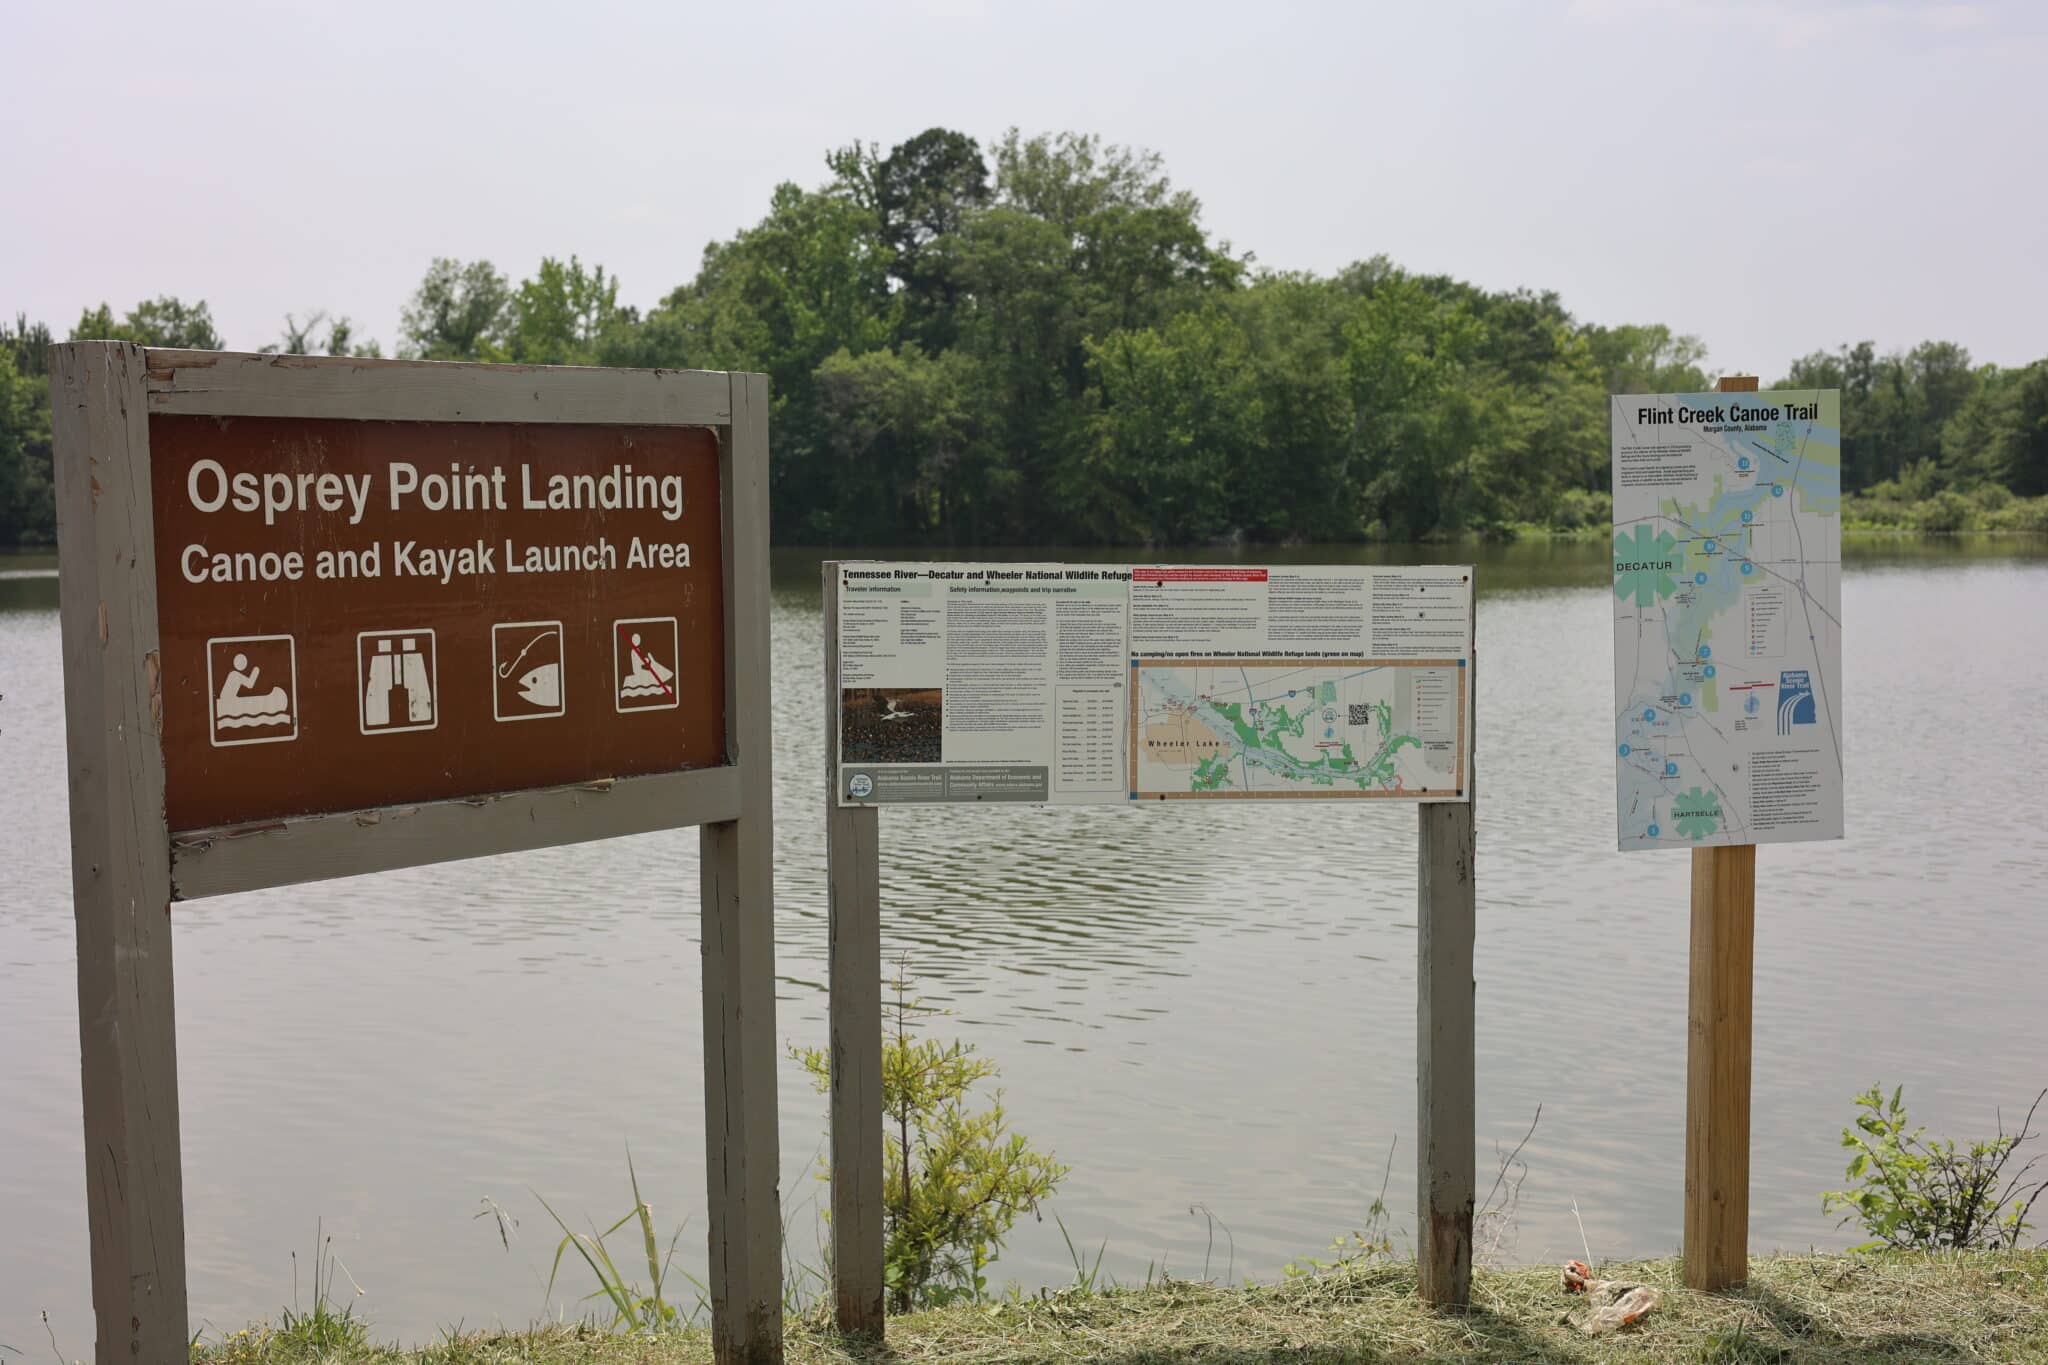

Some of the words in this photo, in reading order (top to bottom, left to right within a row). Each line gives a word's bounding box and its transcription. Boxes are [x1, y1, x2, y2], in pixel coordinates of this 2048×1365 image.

[1638, 408, 1674, 425] Flint
[1678, 406, 1725, 424] Creek
[1729, 404, 1779, 422] Canoe
[1784, 403, 1818, 420] Trail
[1703, 425, 1723, 433] Morgan
[1724, 424, 1743, 432] County,
[1744, 424, 1767, 432] Alabama
[187, 458, 372, 525] Osprey
[388, 461, 507, 511] Point
[521, 463, 684, 521] Landing
[181, 543, 304, 583] Canoe
[315, 542, 381, 579] and
[394, 539, 495, 584] Kayak
[505, 537, 617, 573] Launch
[626, 536, 690, 569] Area
[1616, 561, 1672, 572] DECATUR
[843, 570, 891, 580] Tennessee
[966, 570, 984, 580] and
[986, 570, 1023, 580] Wheeler
[1025, 571, 1062, 580] National
[1065, 571, 1099, 580] Wildlife
[1101, 571, 1132, 581] Refuge
[1673, 810, 1720, 818] HARTSELLE
